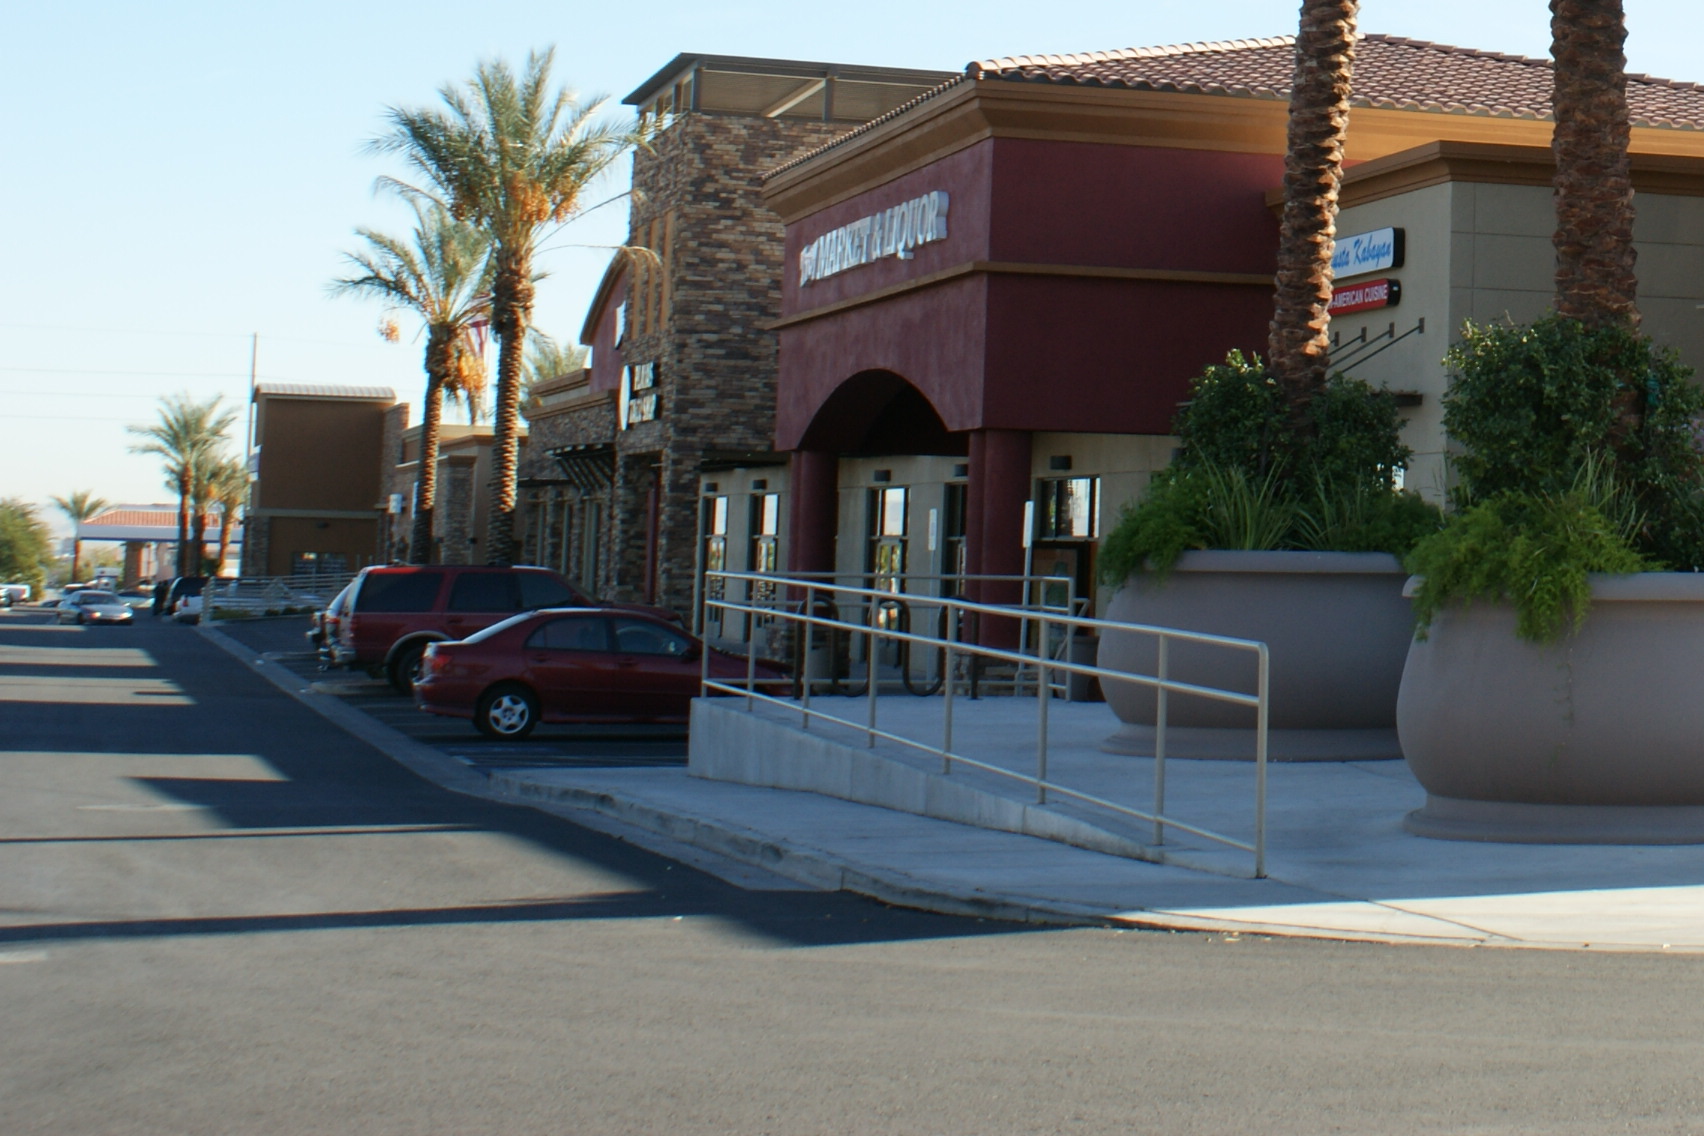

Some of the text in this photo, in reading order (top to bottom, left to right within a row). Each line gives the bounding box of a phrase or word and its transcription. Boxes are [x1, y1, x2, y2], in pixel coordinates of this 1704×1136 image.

[815, 215, 873, 280] MARKET
[872, 212, 885, 261] &
[883, 190, 943, 260] LIQUOR
[1364, 283, 1389, 303] CUISINE
